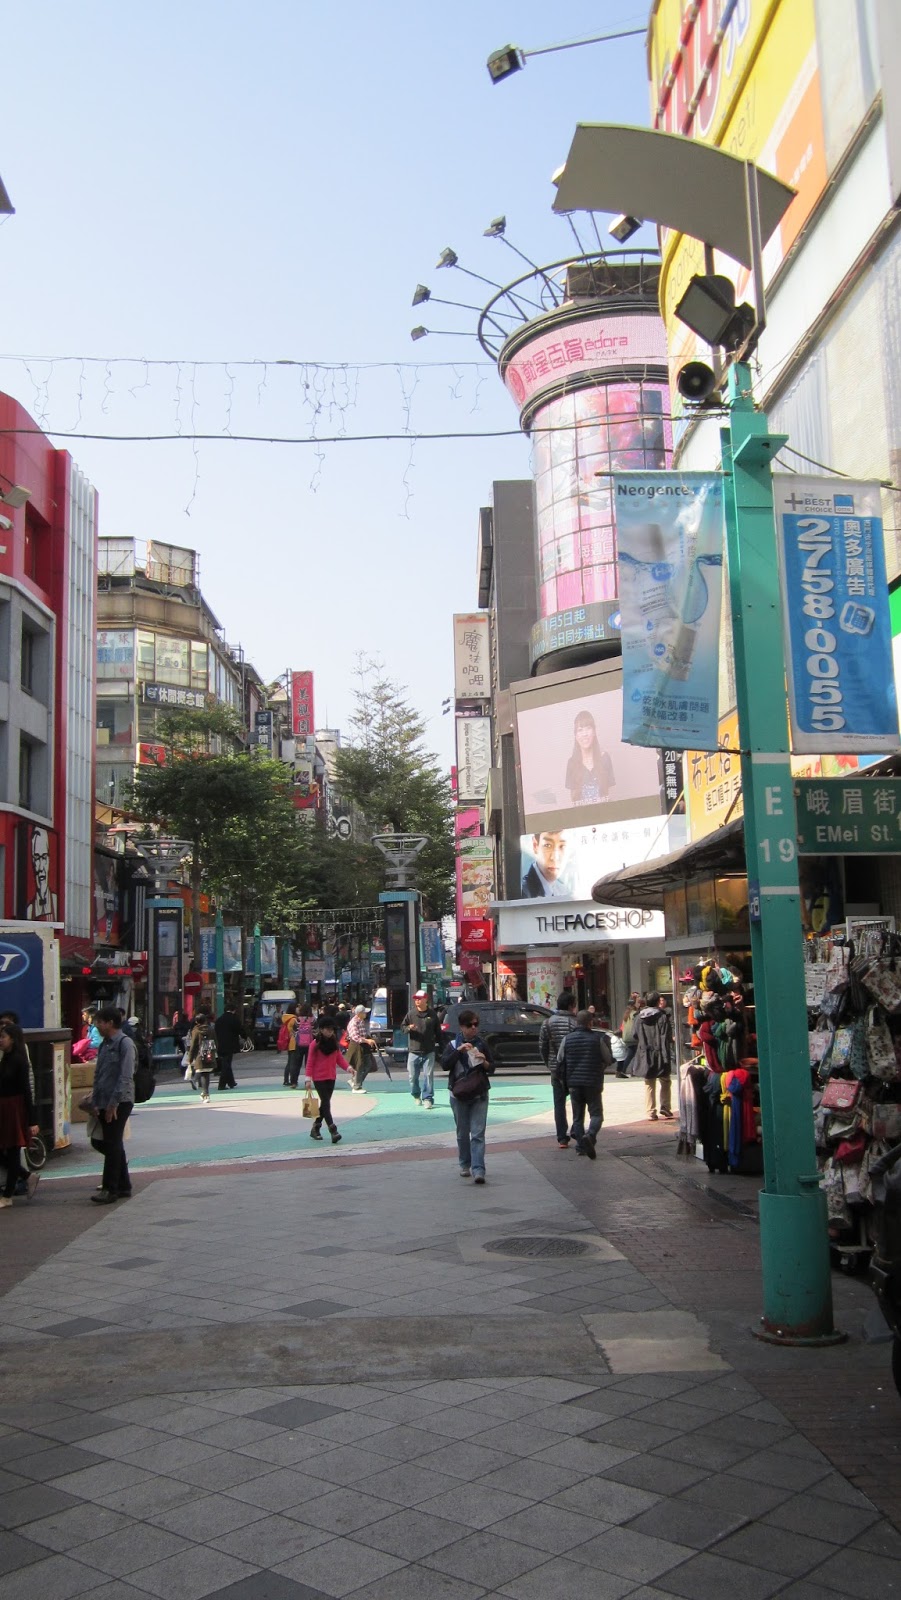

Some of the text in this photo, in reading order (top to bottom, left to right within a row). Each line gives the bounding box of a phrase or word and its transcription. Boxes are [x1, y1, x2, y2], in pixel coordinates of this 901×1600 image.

[617, 484, 690, 499] Neogence
[804, 498, 832, 507] BEST
[843, 519, 866, 596] 奧多廣告
[543, 608, 586, 632] 1月5日起
[549, 624, 606, 648] 台日同步播出
[459, 629, 484, 687] 魔法咖哩
[764, 786, 784, 816] E
[805, 788, 897, 816] 峨眉街
[816, 825, 894, 843] EMei St.
[759, 838, 796, 863] 19
